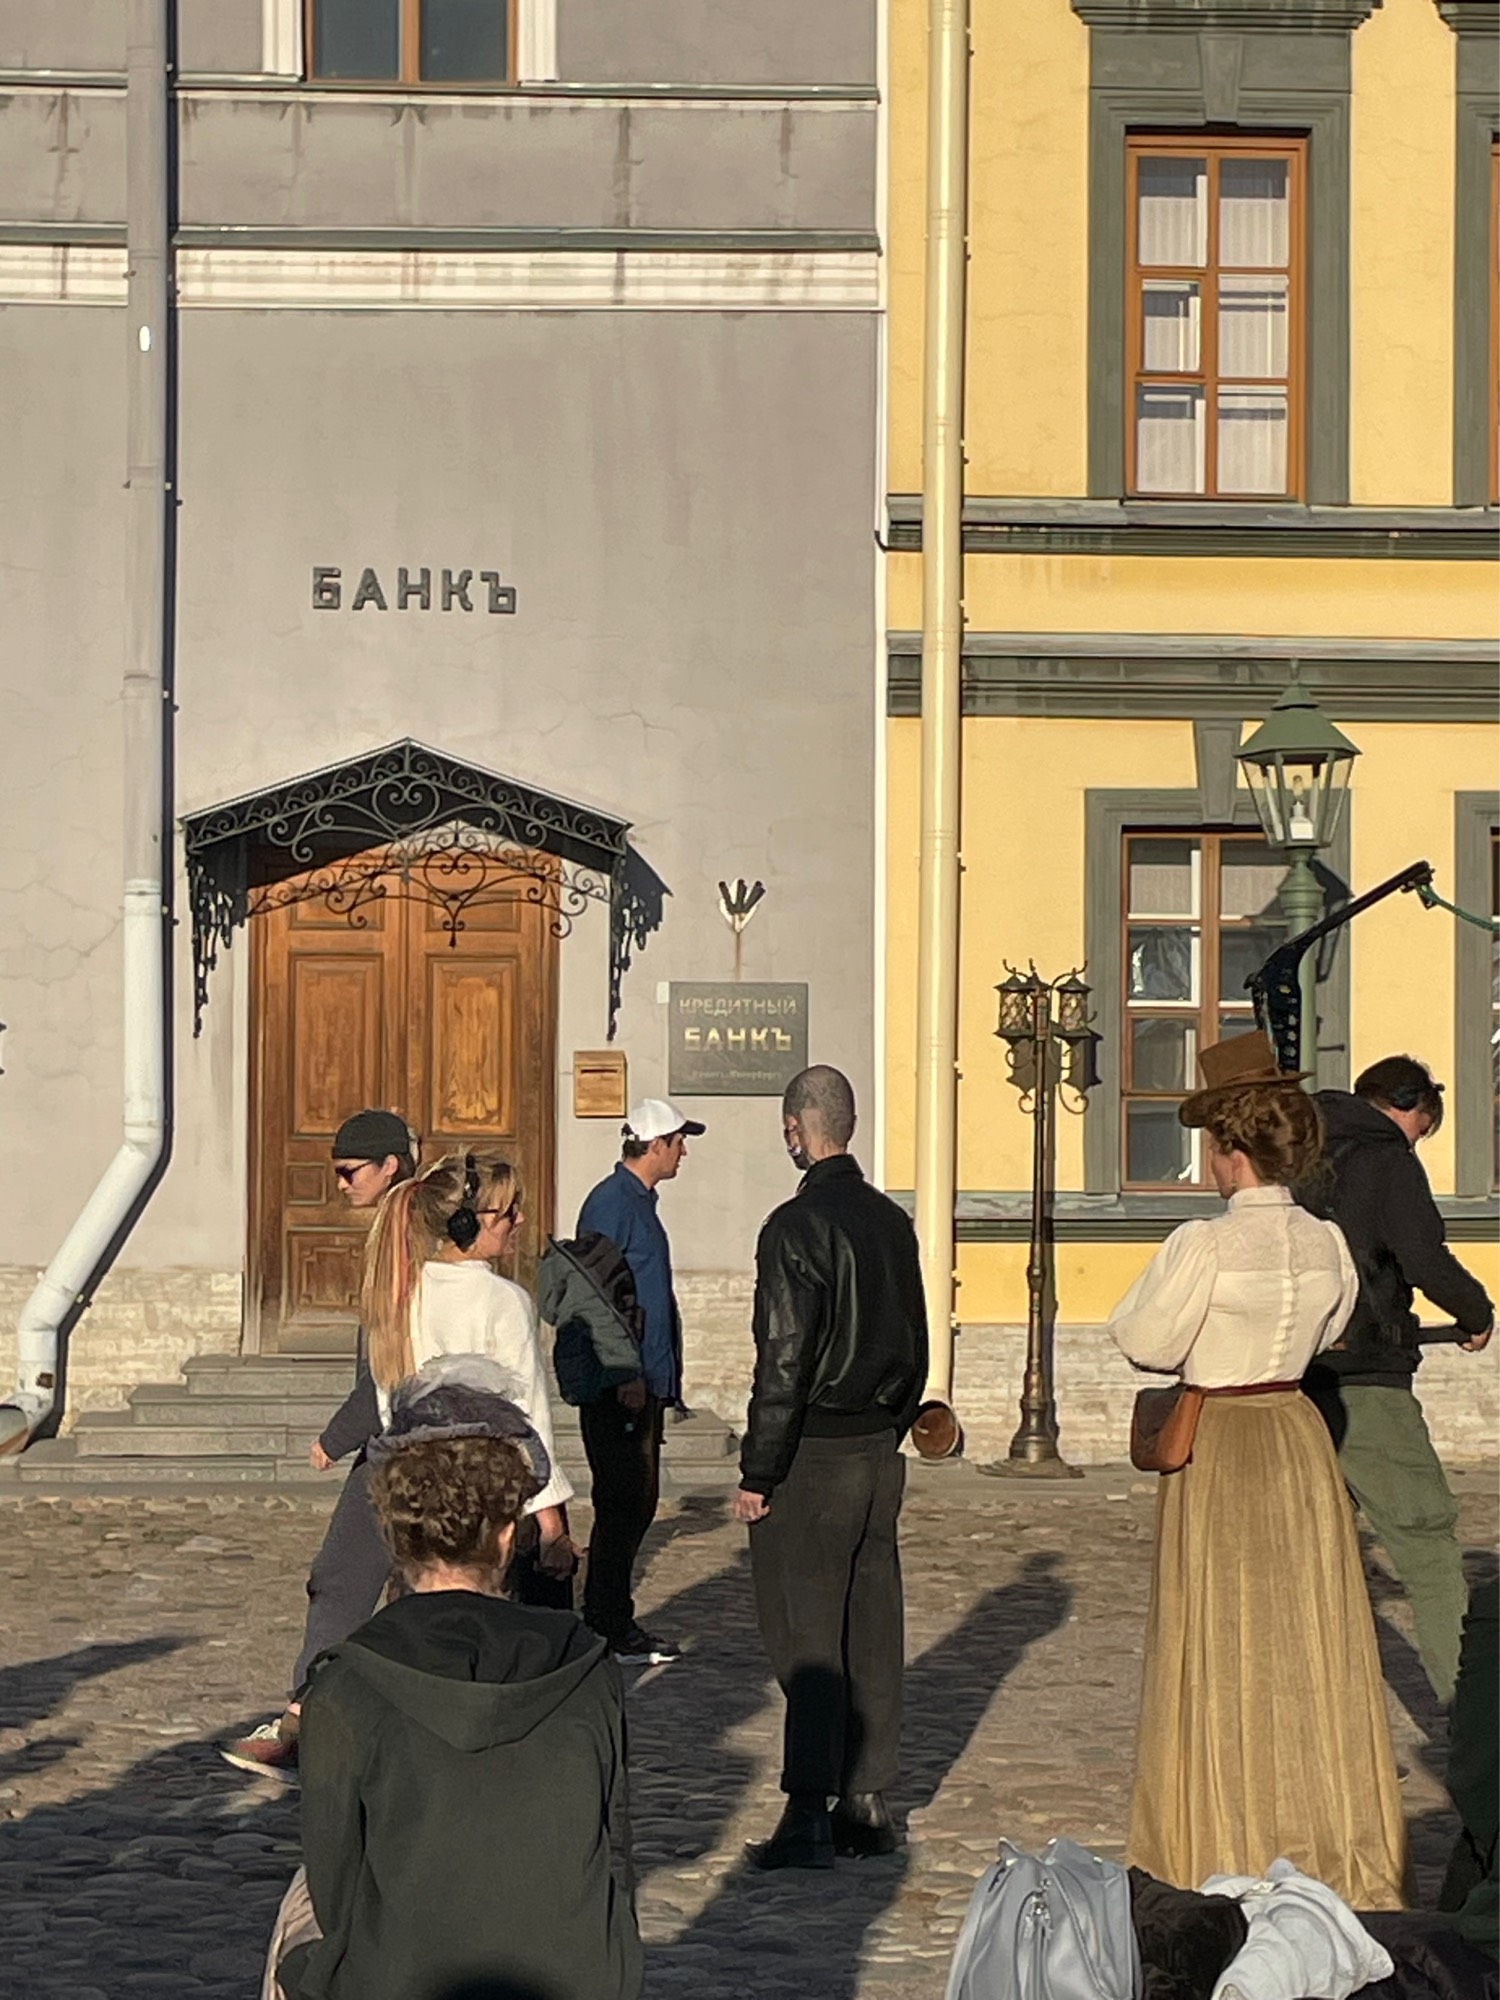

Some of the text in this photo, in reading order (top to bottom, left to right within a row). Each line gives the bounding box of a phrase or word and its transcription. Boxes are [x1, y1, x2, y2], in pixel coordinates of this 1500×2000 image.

[313, 567, 516, 614] БАНКЪ
[679, 995, 797, 1017] КРЕДИТНЫЙ
[684, 1026, 793, 1052] БАНКЪ
